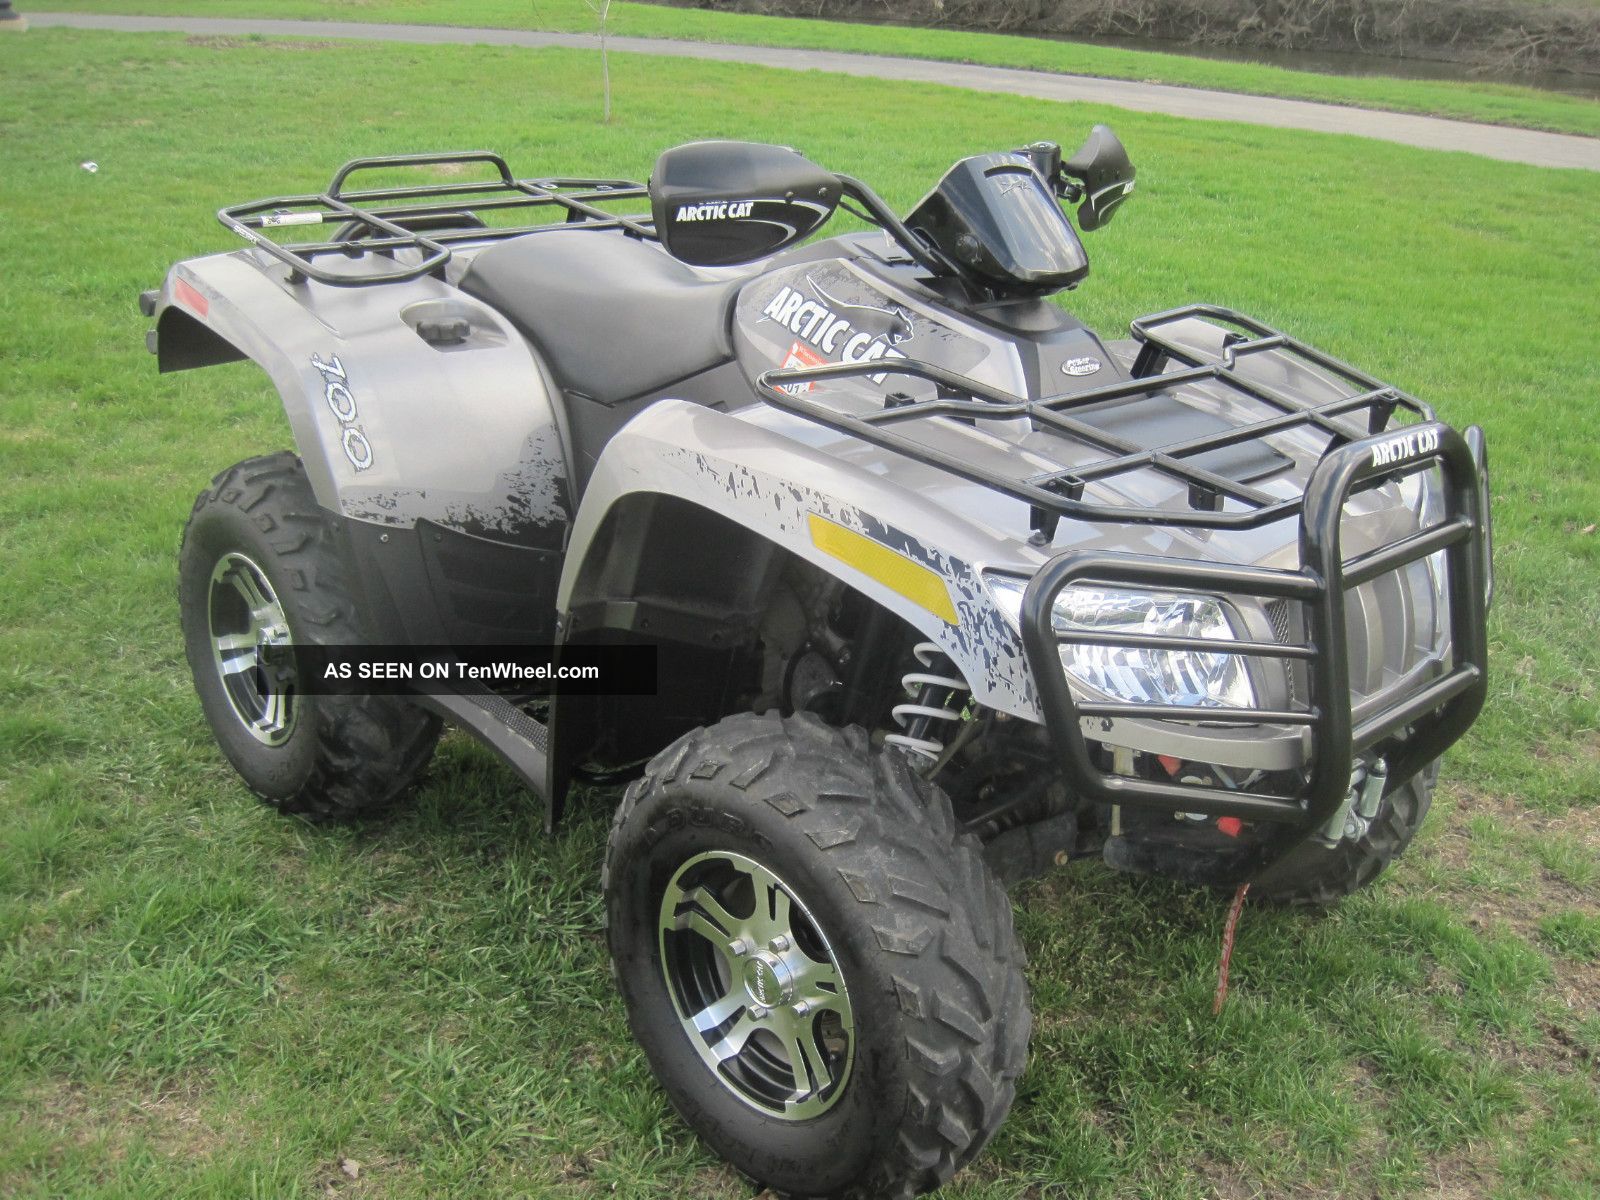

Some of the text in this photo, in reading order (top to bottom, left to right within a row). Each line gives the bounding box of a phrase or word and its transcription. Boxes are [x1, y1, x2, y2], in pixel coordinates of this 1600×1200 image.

[676, 201, 754, 222] ARCTIC CAT
[763, 286, 850, 354] ARCTIC
[310, 352, 374, 472] 700
[1370, 428, 1439, 468] ARCTIC CAT
